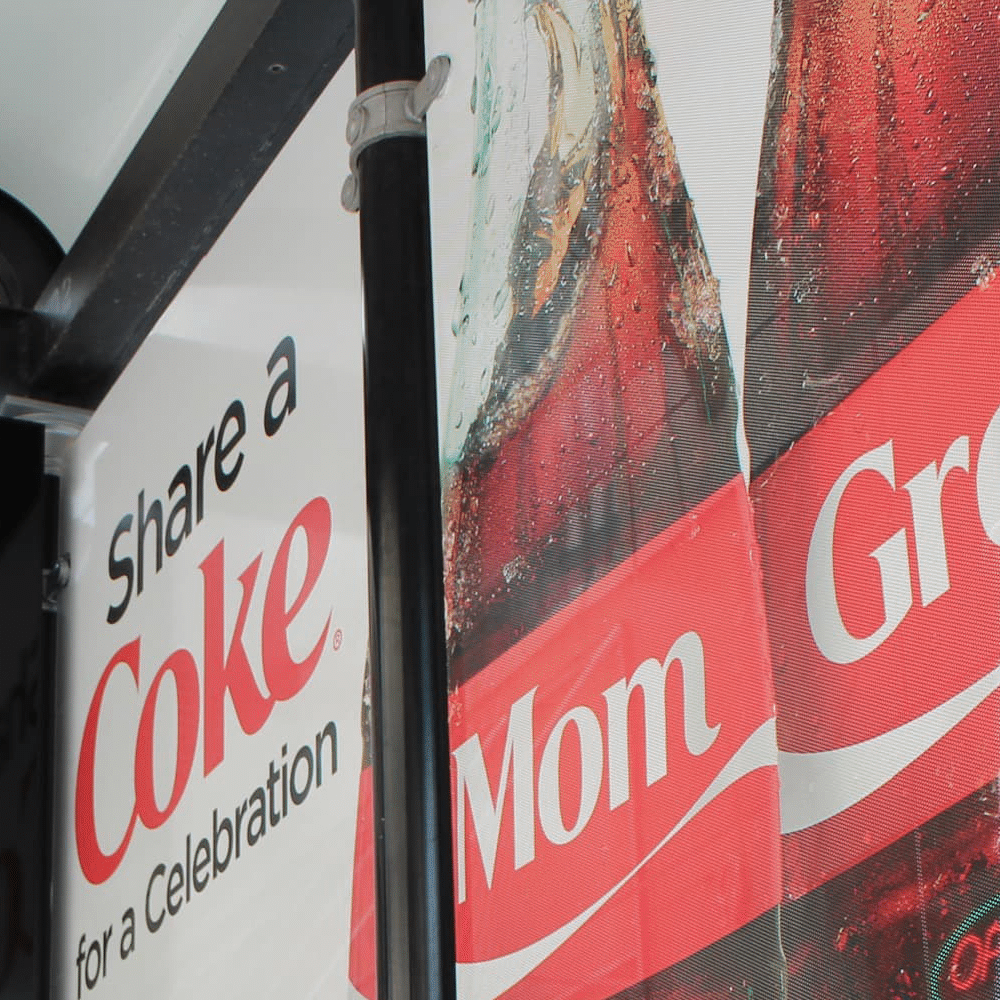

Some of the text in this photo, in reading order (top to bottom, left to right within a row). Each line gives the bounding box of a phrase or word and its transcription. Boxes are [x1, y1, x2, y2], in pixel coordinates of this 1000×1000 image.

[106, 335, 297, 625] Share a
[805, 396, 1000, 665] Gr
[75, 496, 333, 885] Coke
[451, 630, 721, 904] Mom
[76, 720, 338, 1000] for a Celebration
